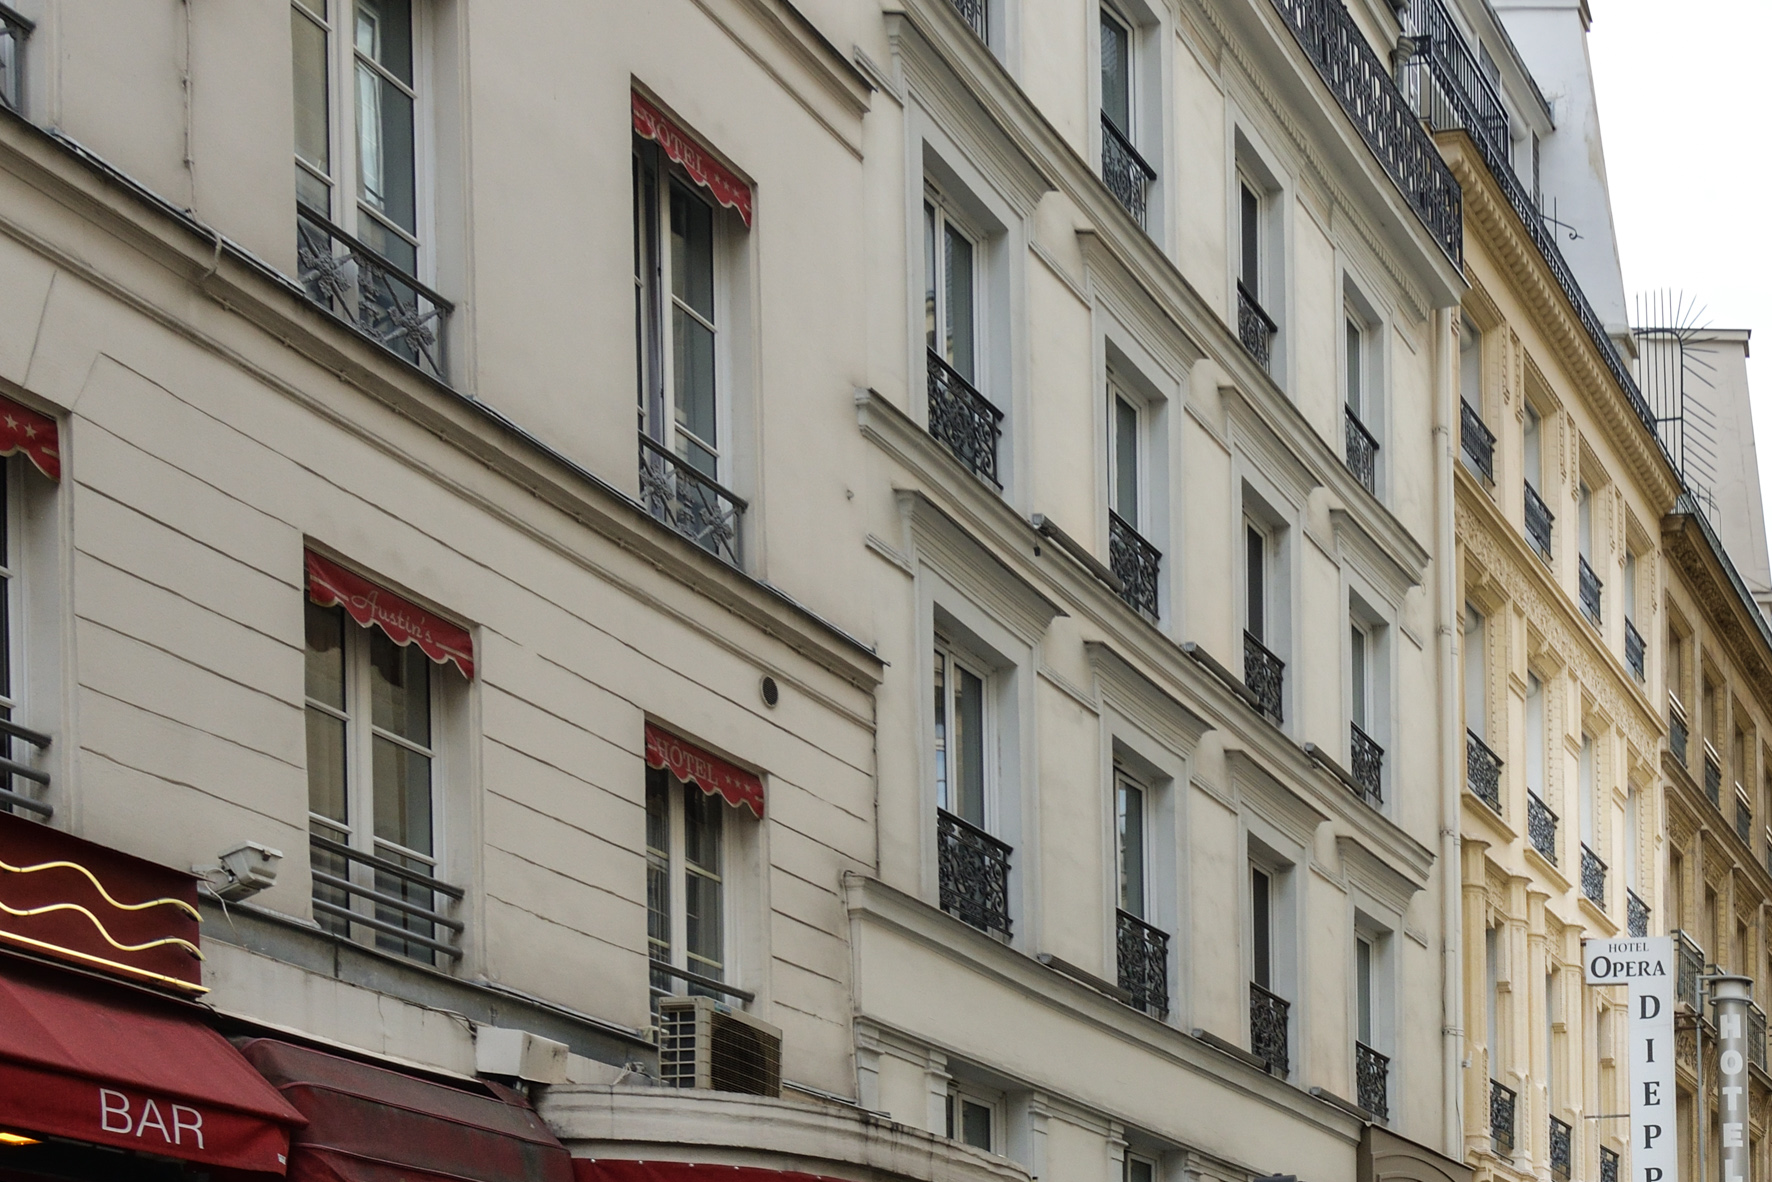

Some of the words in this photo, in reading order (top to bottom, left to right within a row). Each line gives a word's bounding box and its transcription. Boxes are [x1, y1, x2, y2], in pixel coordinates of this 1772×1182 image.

[351, 590, 434, 644] Austin's
[655, 732, 719, 788] HÔTEL
[1608, 942, 1650, 953] HOTEL
[99, 1089, 204, 1150] BAR
